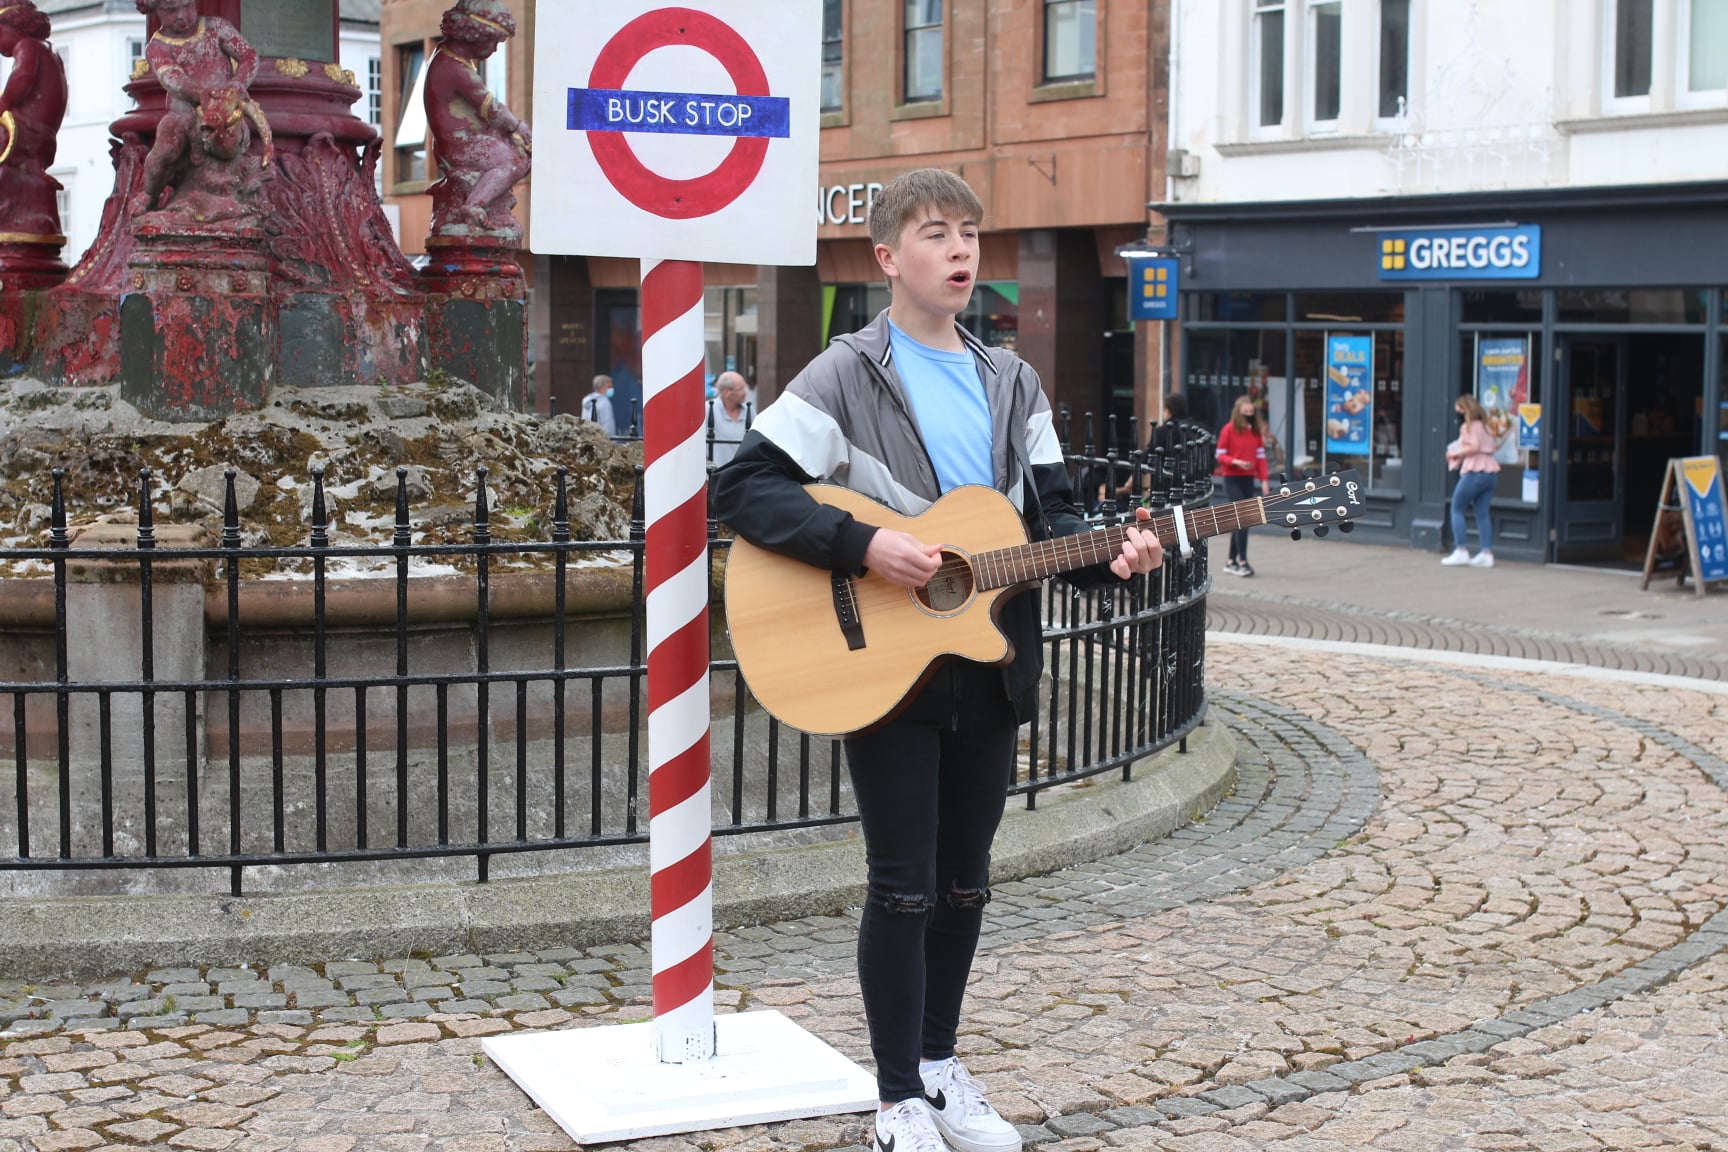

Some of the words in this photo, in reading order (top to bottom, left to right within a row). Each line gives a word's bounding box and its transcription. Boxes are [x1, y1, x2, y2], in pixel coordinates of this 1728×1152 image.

[608, 98, 677, 124] BUSK
[685, 101, 752, 127] STOP
[1409, 234, 1530, 270] GREGGS
[1345, 481, 1361, 505] Cort
